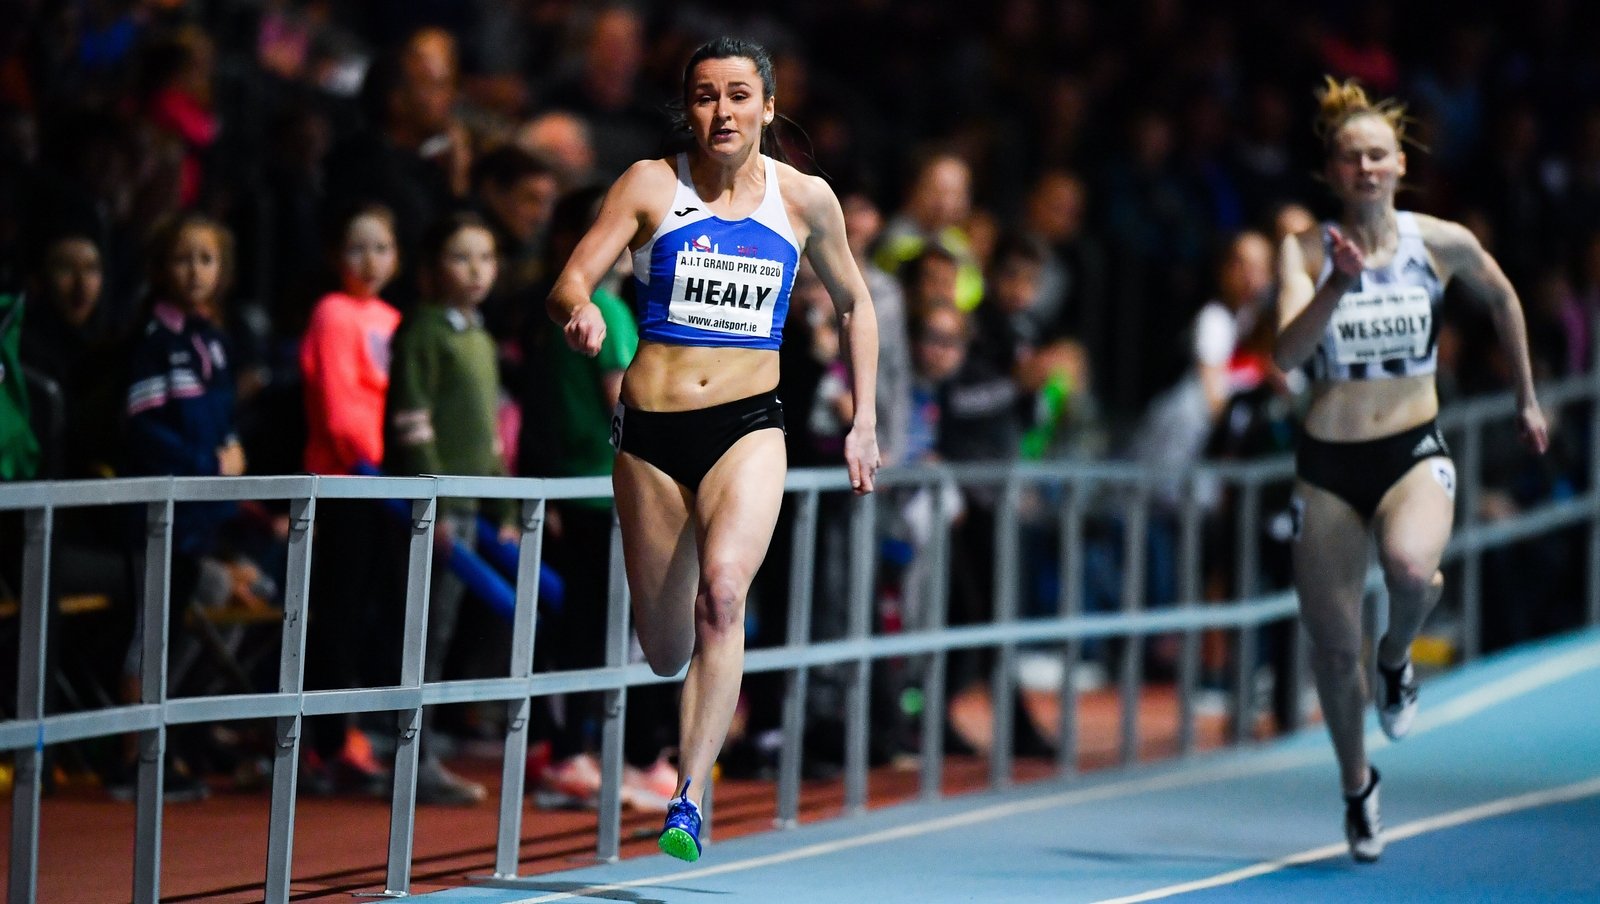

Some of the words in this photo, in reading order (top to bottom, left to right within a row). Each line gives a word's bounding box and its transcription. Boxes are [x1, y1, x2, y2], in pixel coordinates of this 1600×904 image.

[680, 256, 701, 267] A.I.T
[703, 257, 734, 271] GRAND
[737, 262, 757, 274] PRIX
[760, 265, 781, 278] 2020
[684, 277, 772, 311] HEALY
[688, 314, 757, 332] www.aitsport.ie
[1338, 315, 1427, 340] WESSOLY
